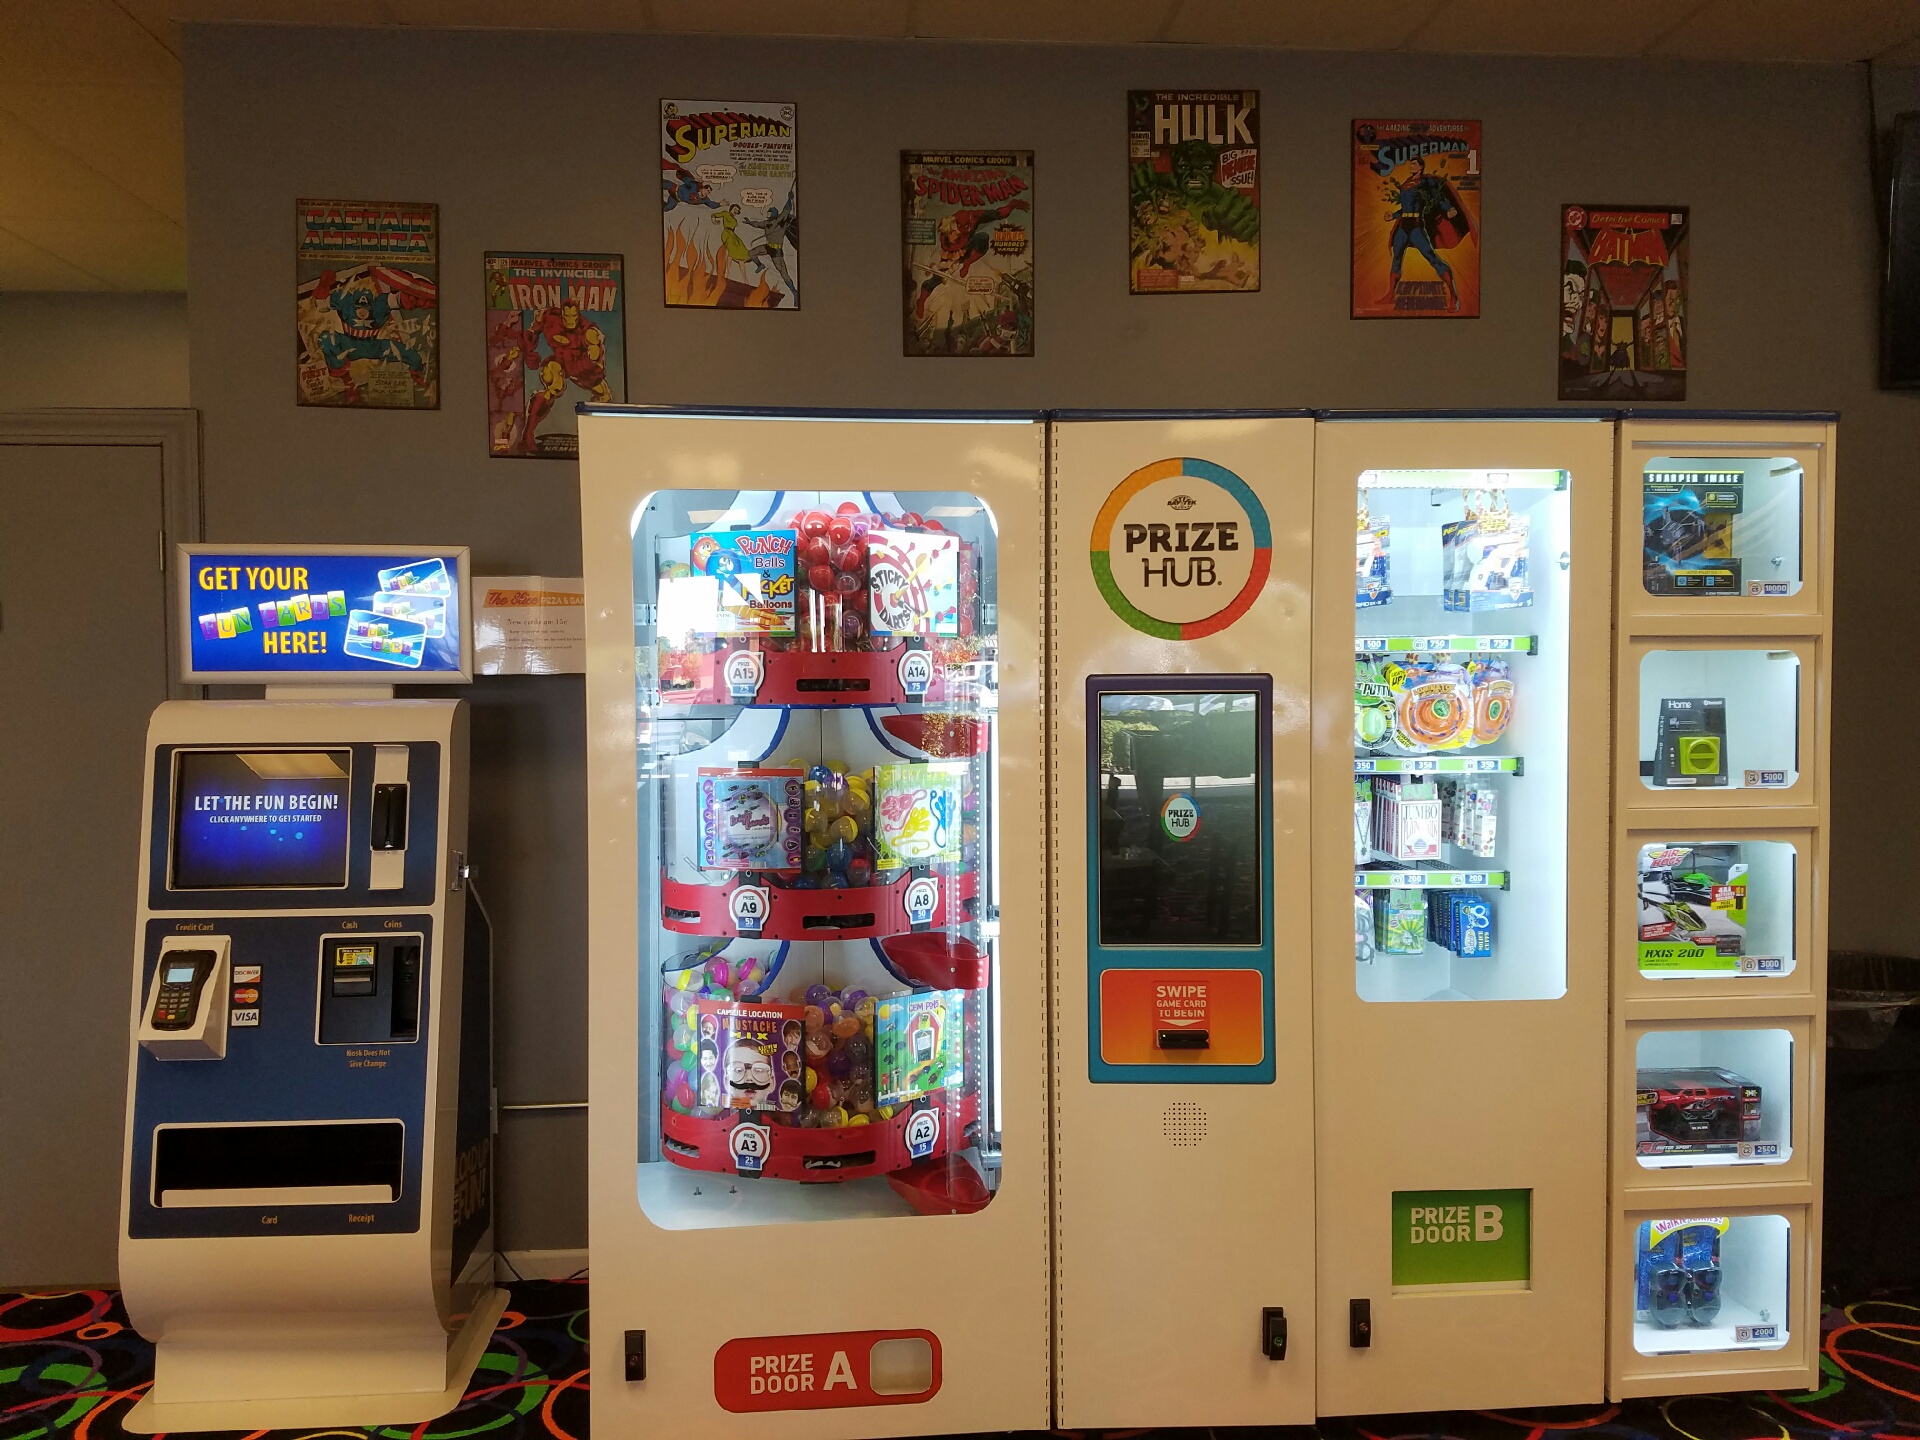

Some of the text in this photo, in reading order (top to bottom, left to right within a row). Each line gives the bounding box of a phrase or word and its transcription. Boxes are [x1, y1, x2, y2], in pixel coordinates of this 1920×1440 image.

[1154, 104, 1254, 144] HULK
[1386, 124, 1464, 132] AMAZING ADVENTURES
[672, 120, 791, 163] SUPERMAN
[954, 156, 984, 164] COMICS
[1222, 152, 1238, 163] BIG
[1377, 141, 1470, 177] SUPERMAN
[1466, 150, 1480, 174] 1
[940, 168, 1006, 182] AMAZING
[1230, 171, 1254, 185] SSUE!
[916, 174, 1028, 207] SPIDER-MAN
[306, 210, 432, 232] CAPTAIN
[1592, 214, 1666, 224] Detective Comics
[300, 231, 430, 252] AMERICA
[547, 260, 579, 268] COMICS
[582, 261, 611, 269] GROUP
[513, 268, 610, 279] THE INVINCIBLE
[508, 280, 618, 312] IRON MAN
[1648, 474, 1740, 482] SHARPER IMAGE
[1124, 522, 1239, 553] PRIZE
[735, 534, 794, 556] PUNCH
[754, 556, 786, 568] Balls
[198, 567, 309, 590] GET YOUR
[762, 570, 770, 578] &
[870, 570, 910, 592] STICKY
[489, 592, 508, 605] The
[200, 593, 346, 639] FUN CARDS
[879, 602, 915, 629] DARTS!
[358, 622, 388, 637] FUN
[264, 632, 328, 654] HERE!
[372, 638, 413, 656] CARD
[1367, 640, 1382, 648] 500
[1430, 640, 1444, 648] 750
[1494, 640, 1508, 648] 750
[733, 668, 754, 680] A15
[908, 666, 926, 678] A14
[912, 682, 920, 690] 75
[1392, 676, 1406, 687] UP!
[740, 684, 750, 692] 75
[1356, 762, 1371, 770] 350
[1480, 760, 1495, 768] 350
[882, 770, 920, 782] STCKY
[194, 794, 338, 812] LET THE FUN BEGIN!
[1168, 809, 1194, 818] PRIZE
[1402, 805, 1438, 820] JUMBO
[210, 816, 229, 824] CLICK
[230, 815, 268, 824] ANYWHERE
[269, 815, 277, 823] TO
[292, 814, 322, 822] STARTED
[1172, 818, 1190, 828] HUB
[1661, 850, 1678, 858] AIR
[1651, 857, 1682, 868] HOGS
[1408, 874, 1422, 882] 200
[1468, 874, 1482, 882] 200
[914, 894, 929, 907] A8
[740, 902, 757, 914] A9
[918, 910, 926, 918] 50
[175, 923, 214, 931] Credit Card
[342, 920, 403, 930] Cash Coins
[745, 918, 754, 926] 50
[1645, 948, 1704, 958] AXIS 200
[1760, 960, 1779, 968] 3000
[1156, 986, 1206, 998] SWIPE
[1156, 1000, 1206, 1008] GAME CARD
[234, 1012, 258, 1022] VISA
[716, 1008, 783, 1018] CAPSULE LOCATION
[1158, 1009, 1205, 1018] TO BEGIN
[722, 1018, 778, 1033] MUSTACHE
[914, 1126, 930, 1140] A2
[741, 1140, 758, 1152] A3
[919, 1143, 926, 1151] 15
[745, 1156, 754, 1165] 25
[262, 1214, 375, 1224] Card Receipt
[1410, 1206, 1470, 1225] PRIZE
[1475, 1204, 1504, 1242] B
[1410, 1225, 1470, 1244] DOOR
[1755, 1328, 1772, 1336] 2000
[750, 1353, 814, 1374] PRIZE
[822, 1350, 858, 1391] A
[750, 1374, 814, 1395] DOOR
